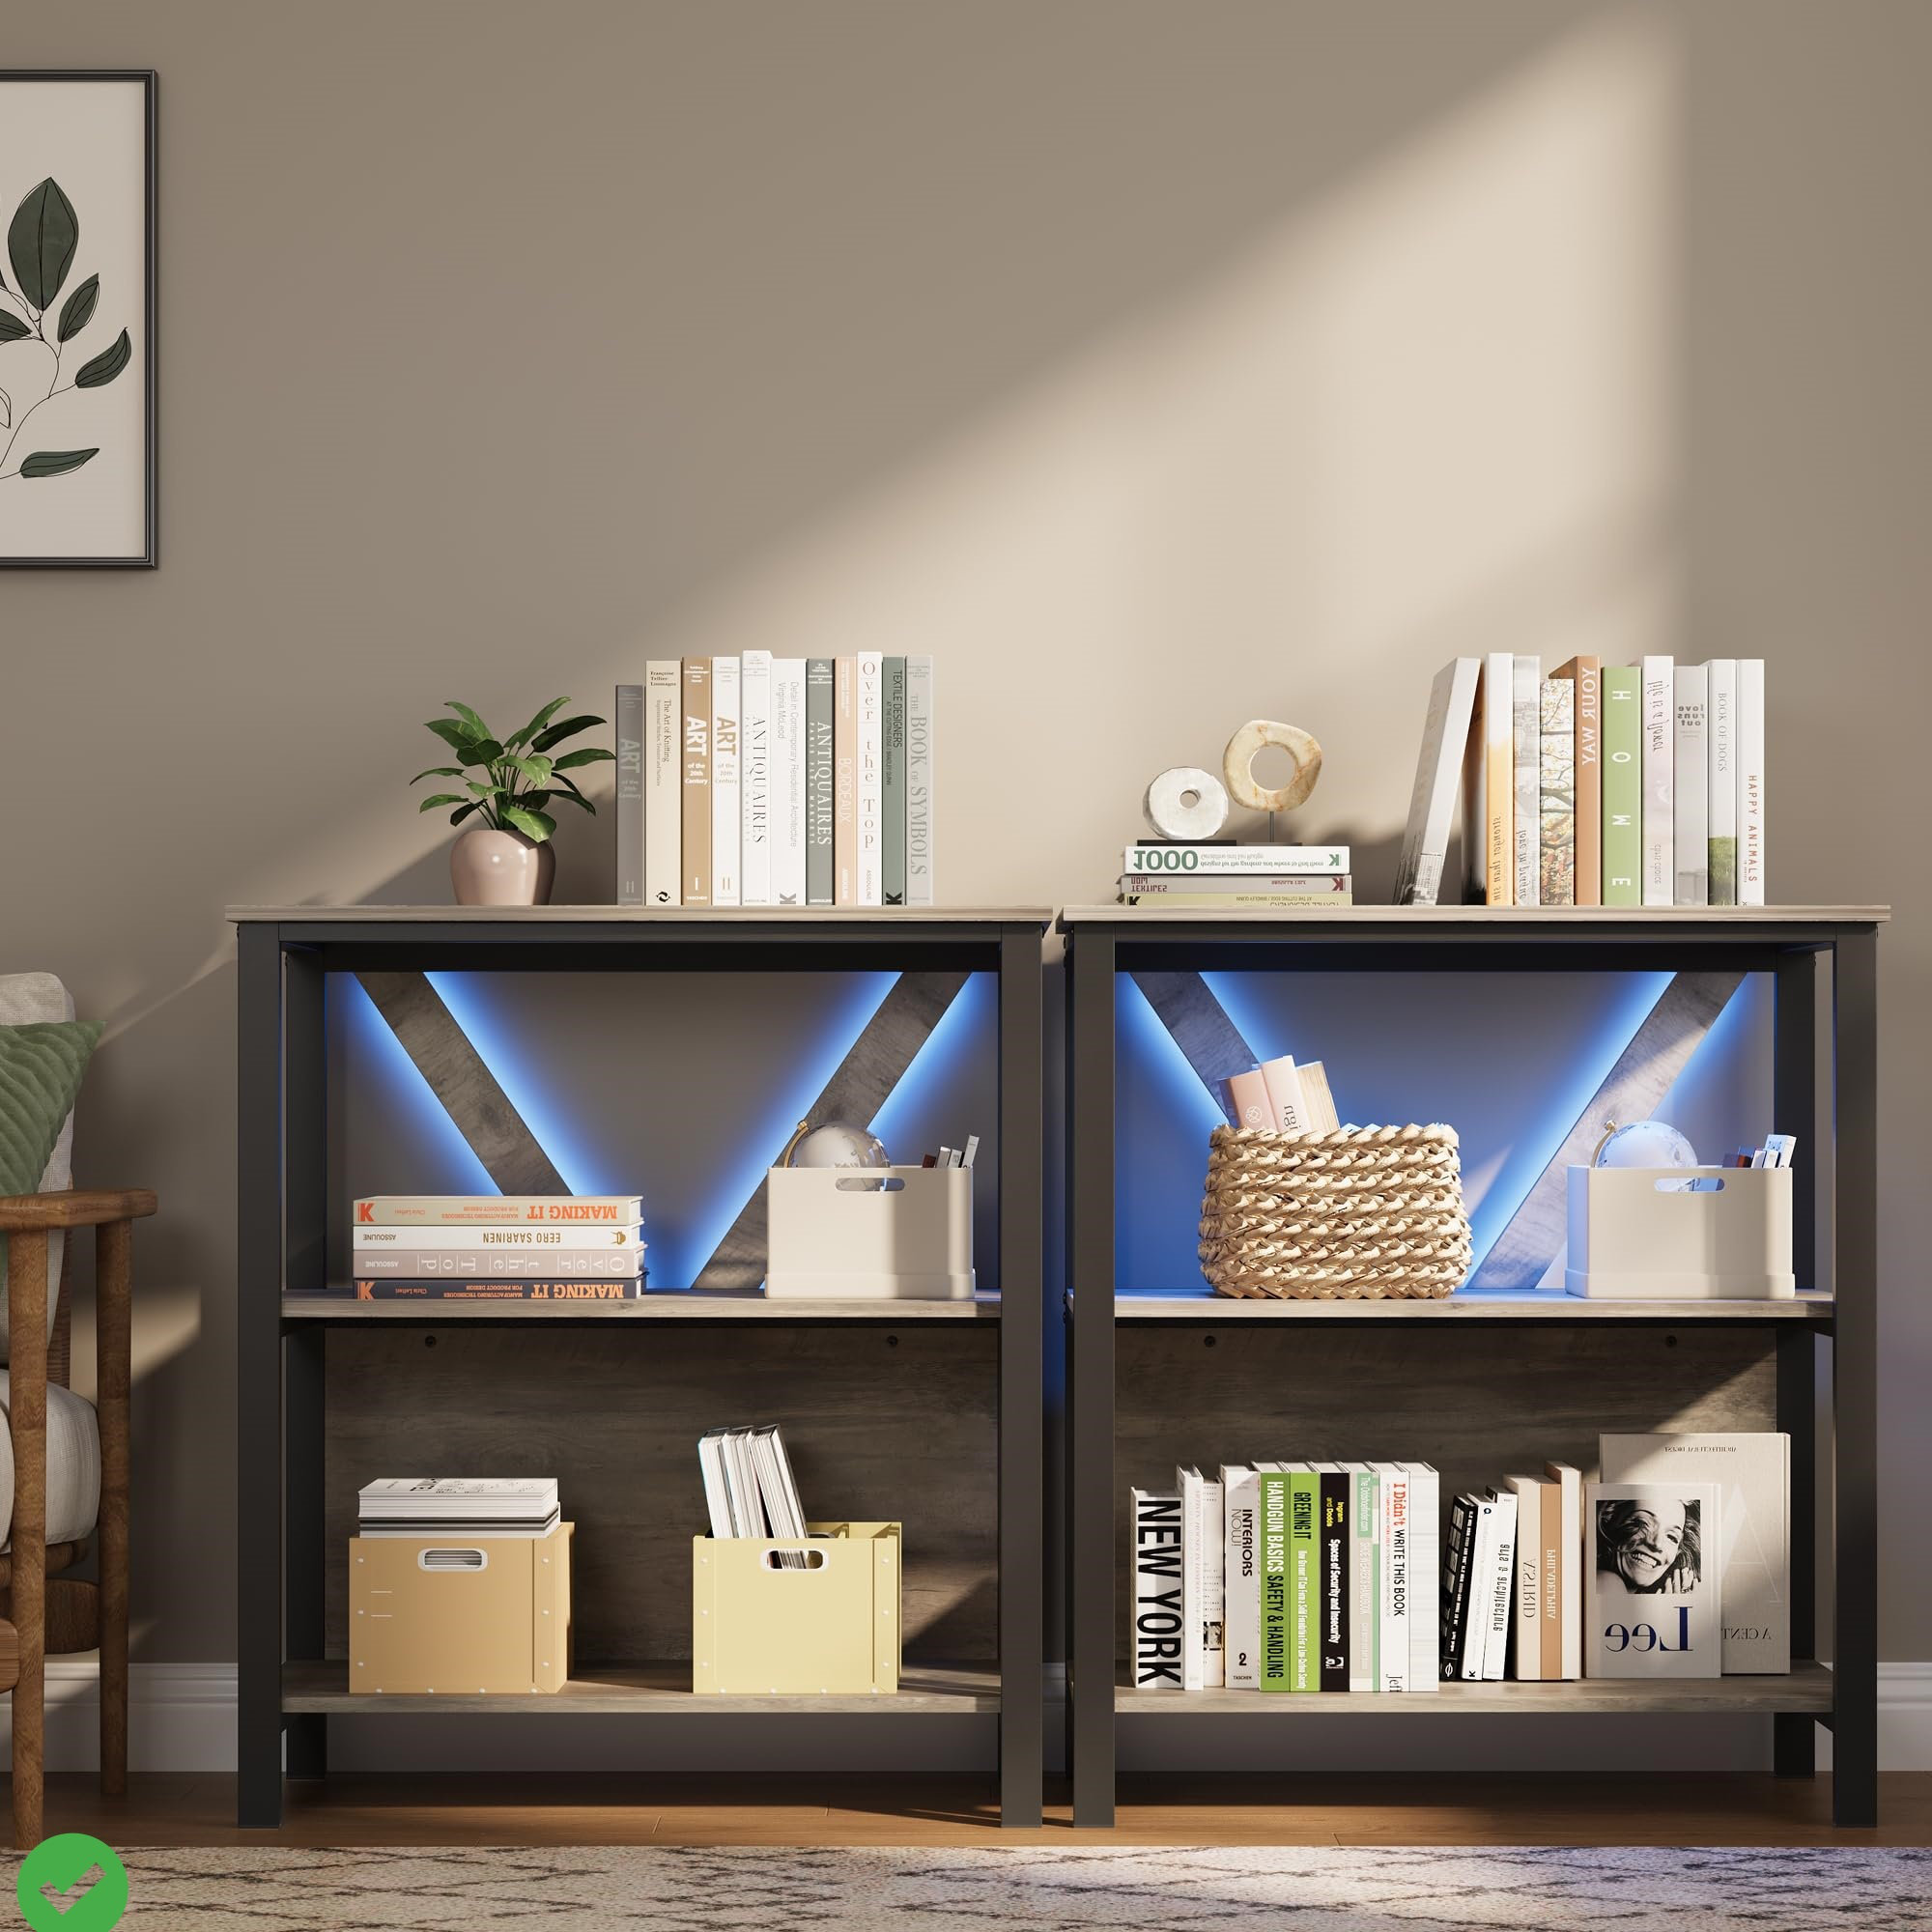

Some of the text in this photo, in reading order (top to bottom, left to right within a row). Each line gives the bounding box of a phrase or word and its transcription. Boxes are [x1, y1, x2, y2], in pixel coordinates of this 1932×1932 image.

[790, 681, 799, 702] Detail
[863, 662, 875, 720] Over
[893, 670, 903, 748] TEXTILE DESIGNERS
[663, 735, 672, 762] Knitting
[687, 716, 707, 756] ART
[717, 717, 737, 756] ART
[911, 717, 927, 766] BOOK
[1718, 693, 1727, 771] BOOK OF DOGS
[620, 739, 640, 773] ART
[865, 741, 874, 781] the
[750, 717, 766, 843] ANTIQUAIRES
[814, 722, 831, 845] ANTIQUAIRES
[840, 757, 851, 824] BORDEAUX
[911, 787, 927, 875] SYMBOLS
[1748, 775, 1757, 882] HAPPY ANIMALS
[886, 892, 902, 905] K
[527, 1206, 617, 1219] MAKING IT
[483, 1233, 560, 1243] EERO SAARINEN
[421, 1256, 625, 1271] Over the Top
[532, 1284, 623, 1298] MAKING IT
[1360, 1477, 1370, 1487] The
[1267, 1482, 1284, 1531] HANDGUN
[1294, 1492, 1311, 1530] GREENING
[1336, 1502, 1344, 1522] Ingram
[1394, 1492, 1406, 1526] Didn't
[1242, 1509, 1252, 1577] INTERIORS
[1267, 1535, 1284, 1572] BASICS
[1328, 1539, 1341, 1562] Spaces
[1394, 1529, 1405, 1559] WRITE
[1328, 1570, 1341, 1597] Security
[1394, 1562, 1405, 1585] THIS
[1137, 1501, 1182, 1684] NEW YORK
[1267, 1575, 1284, 1612] SAFETY
[1330, 1598, 1341, 1610] and
[1394, 1588, 1405, 1616] BOOK
[1328, 1611, 1341, 1643] Insecurity
[1239, 1653, 1247, 1666] 2
[1267, 1626, 1284, 1678] HANDLING
